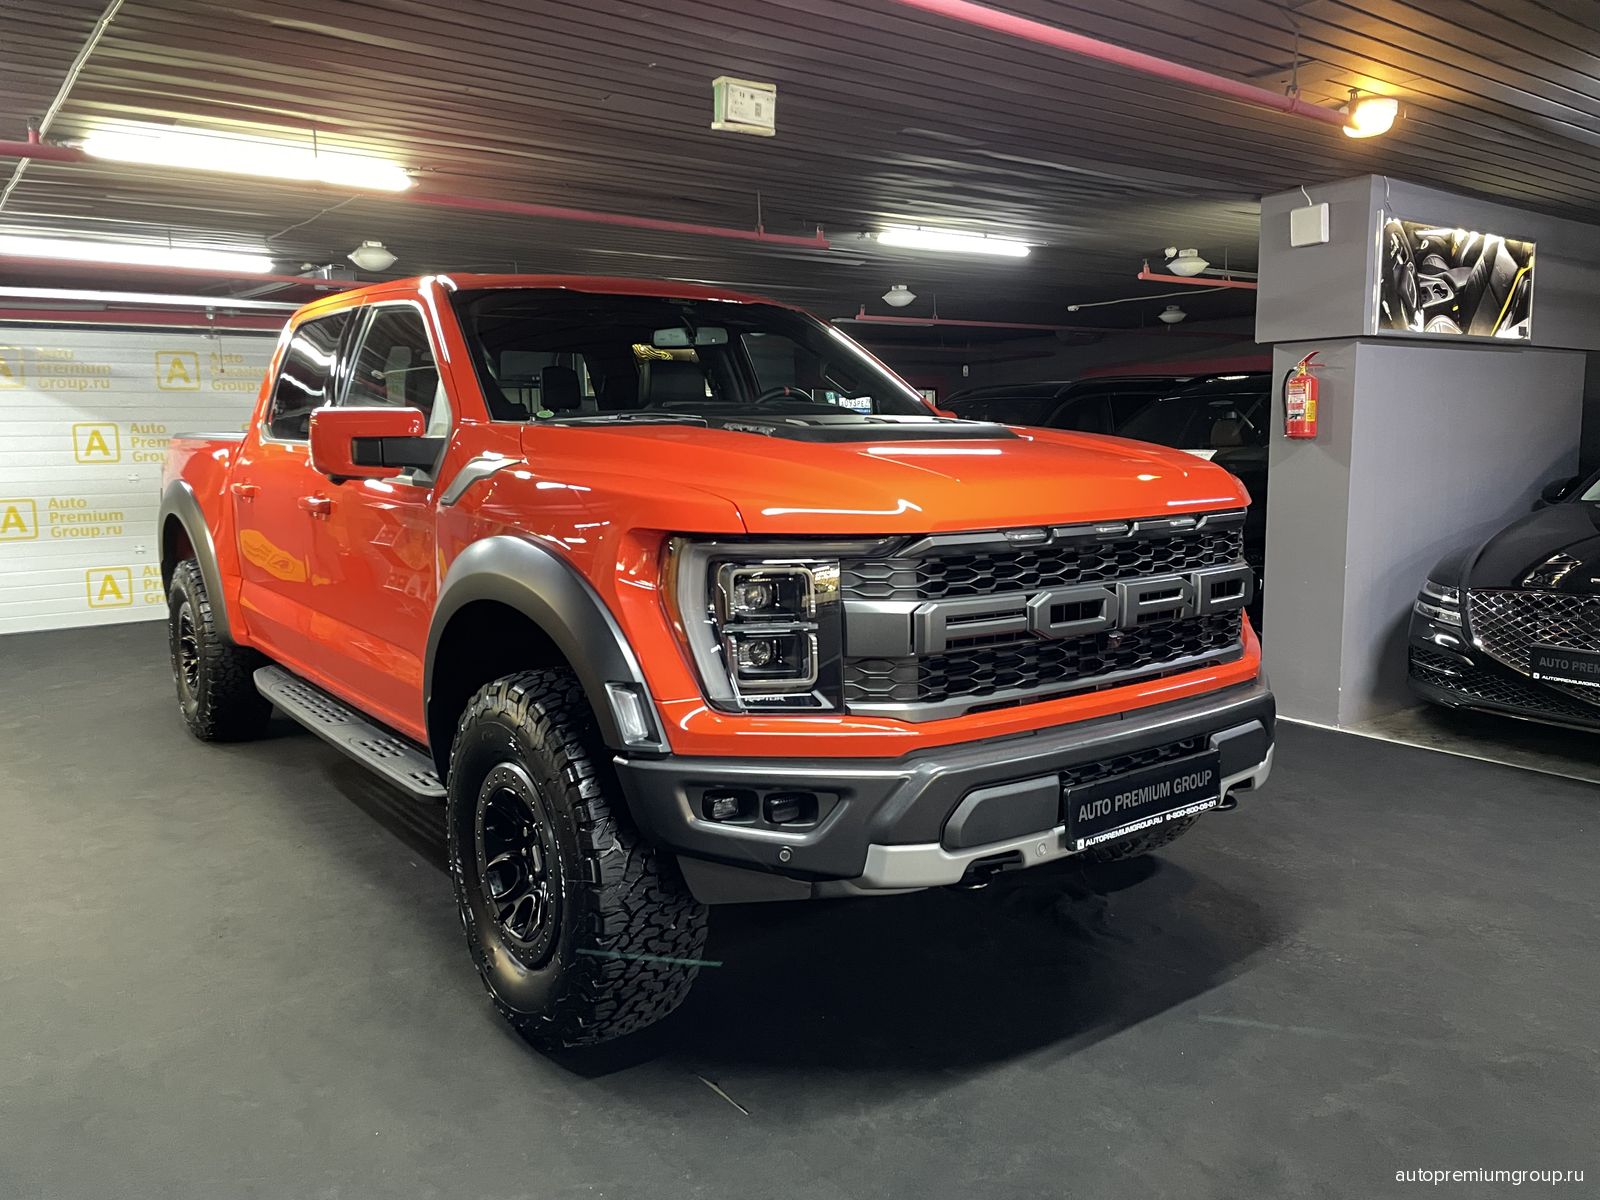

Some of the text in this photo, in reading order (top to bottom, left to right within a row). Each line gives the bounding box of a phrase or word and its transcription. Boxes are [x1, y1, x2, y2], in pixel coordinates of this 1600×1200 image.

[38, 377, 111, 390] Group.ru
[130, 422, 166, 434] Auto
[131, 436, 170, 449] Prem
[48, 497, 87, 509] Auto
[49, 510, 124, 524] Premium
[50, 525, 122, 538] Group.ru
[913, 563, 1253, 656] FORD
[1539, 656, 1600, 674] AUTO PREM
[1078, 769, 1213, 823] AUTO PREMIUM GROUP
